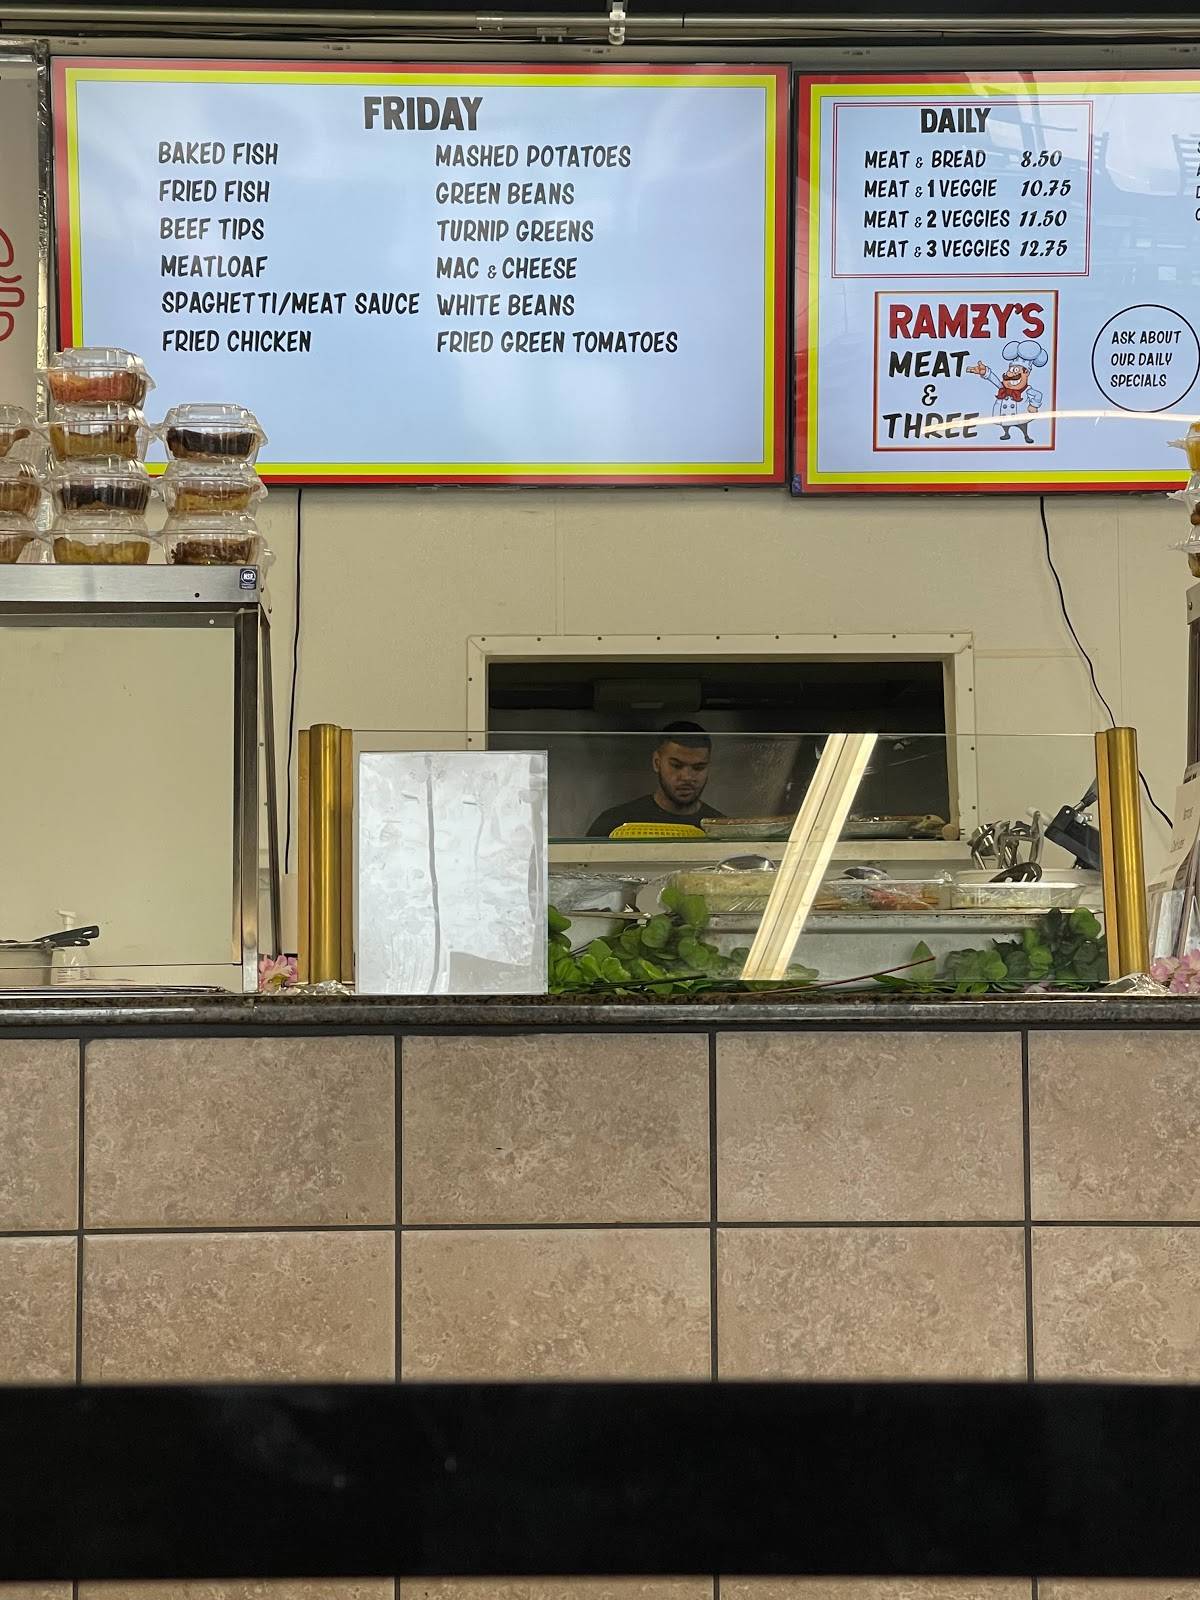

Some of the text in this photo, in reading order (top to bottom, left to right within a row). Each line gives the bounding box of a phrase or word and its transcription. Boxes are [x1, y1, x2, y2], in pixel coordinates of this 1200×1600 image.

[364, 96, 483, 130] FRIDAY
[920, 108, 990, 133] DAILY
[159, 142, 278, 164] BAKED FISH
[436, 145, 631, 168] MASHED POTATOES
[865, 150, 1062, 169] MEAT & BREAD 8.50
[159, 180, 269, 202] FRIED FISH
[436, 182, 574, 205] GREEN BEANS
[864, 179, 1071, 197] MEAT & 1 VEGGIE 10.75
[160, 218, 264, 240] BEEF TIPS
[864, 210, 1067, 228] MEAT & 2 VEGGIES 11.50
[437, 220, 593, 242] TURNIP GREENS
[864, 239, 1067, 258] MEAT & 3 VEGGIES 12.75
[161, 255, 268, 277] MEATLOAF
[436, 257, 577, 279] MAC & CHEESE
[162, 292, 419, 316] SPAGHETTI/MEAT SAUCE
[437, 294, 574, 316] WHITE BEANS
[889, 303, 1044, 339] RAMZY'S
[162, 330, 311, 352] FRIED CHICKEN
[437, 331, 678, 352] FRIED GREEN TOMATOES
[1111, 331, 1182, 344] ASK ABOUT
[888, 351, 970, 378] MEAT
[1111, 353, 1172, 366] OUR DAILY
[1110, 374, 1166, 387] SPECIALS
[922, 384, 938, 406] &
[883, 412, 979, 439] THREE
